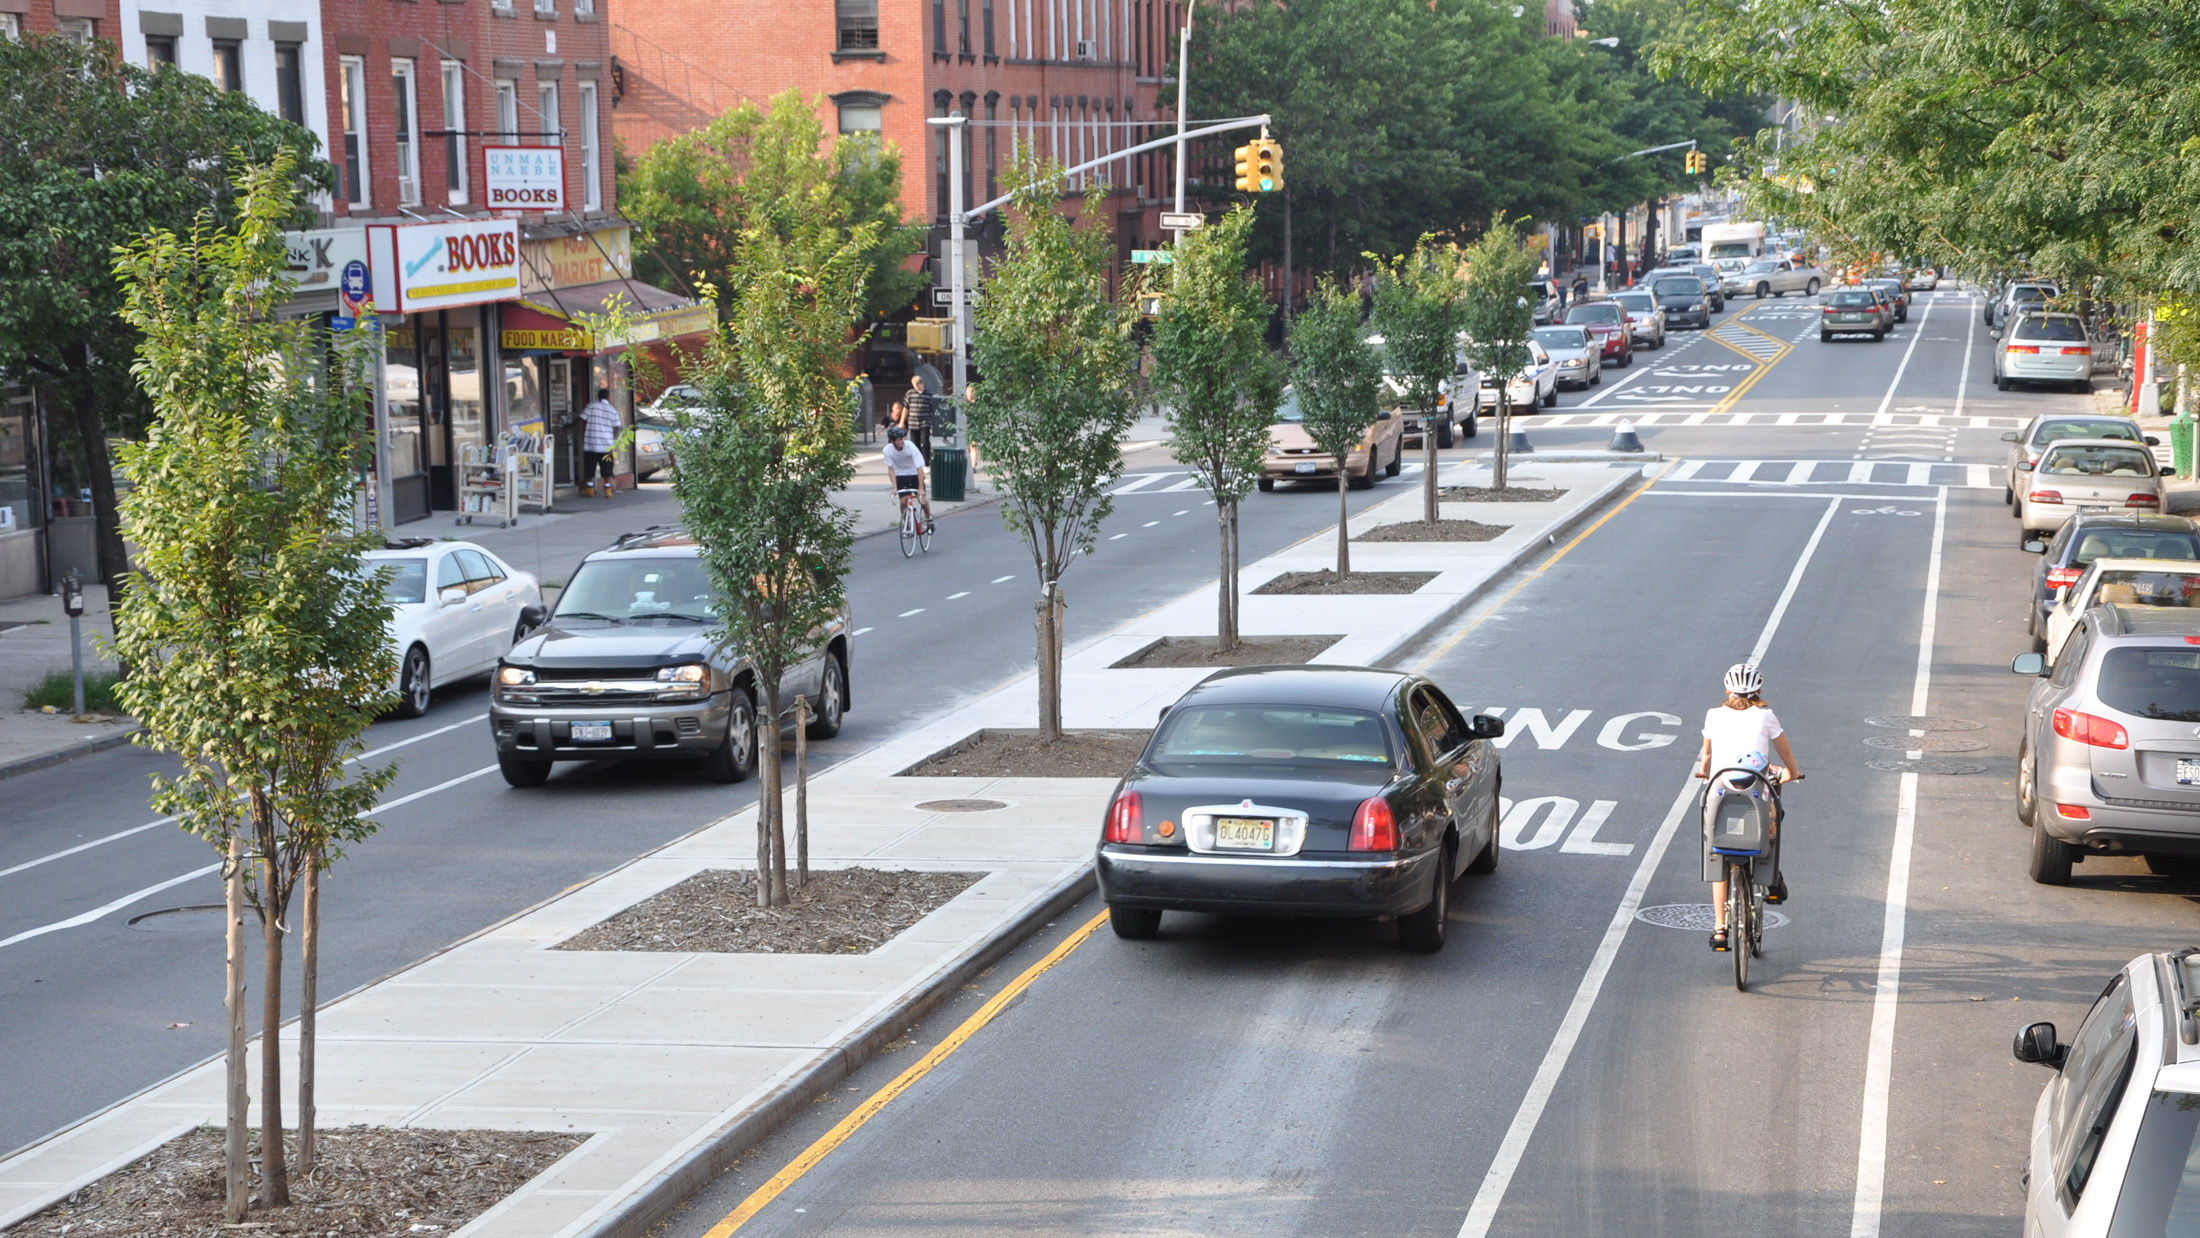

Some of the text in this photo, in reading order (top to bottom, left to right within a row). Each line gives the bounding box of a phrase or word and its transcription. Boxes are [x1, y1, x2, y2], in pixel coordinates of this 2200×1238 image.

[490, 154, 556, 164] UNMAL
[491, 188, 558, 203] BOOKS
[445, 231, 516, 273] BOOKS
[552, 257, 603, 287] MARKET
[505, 331, 586, 347] FOOD MARKET
[1614, 385, 1730, 395] ONLY
